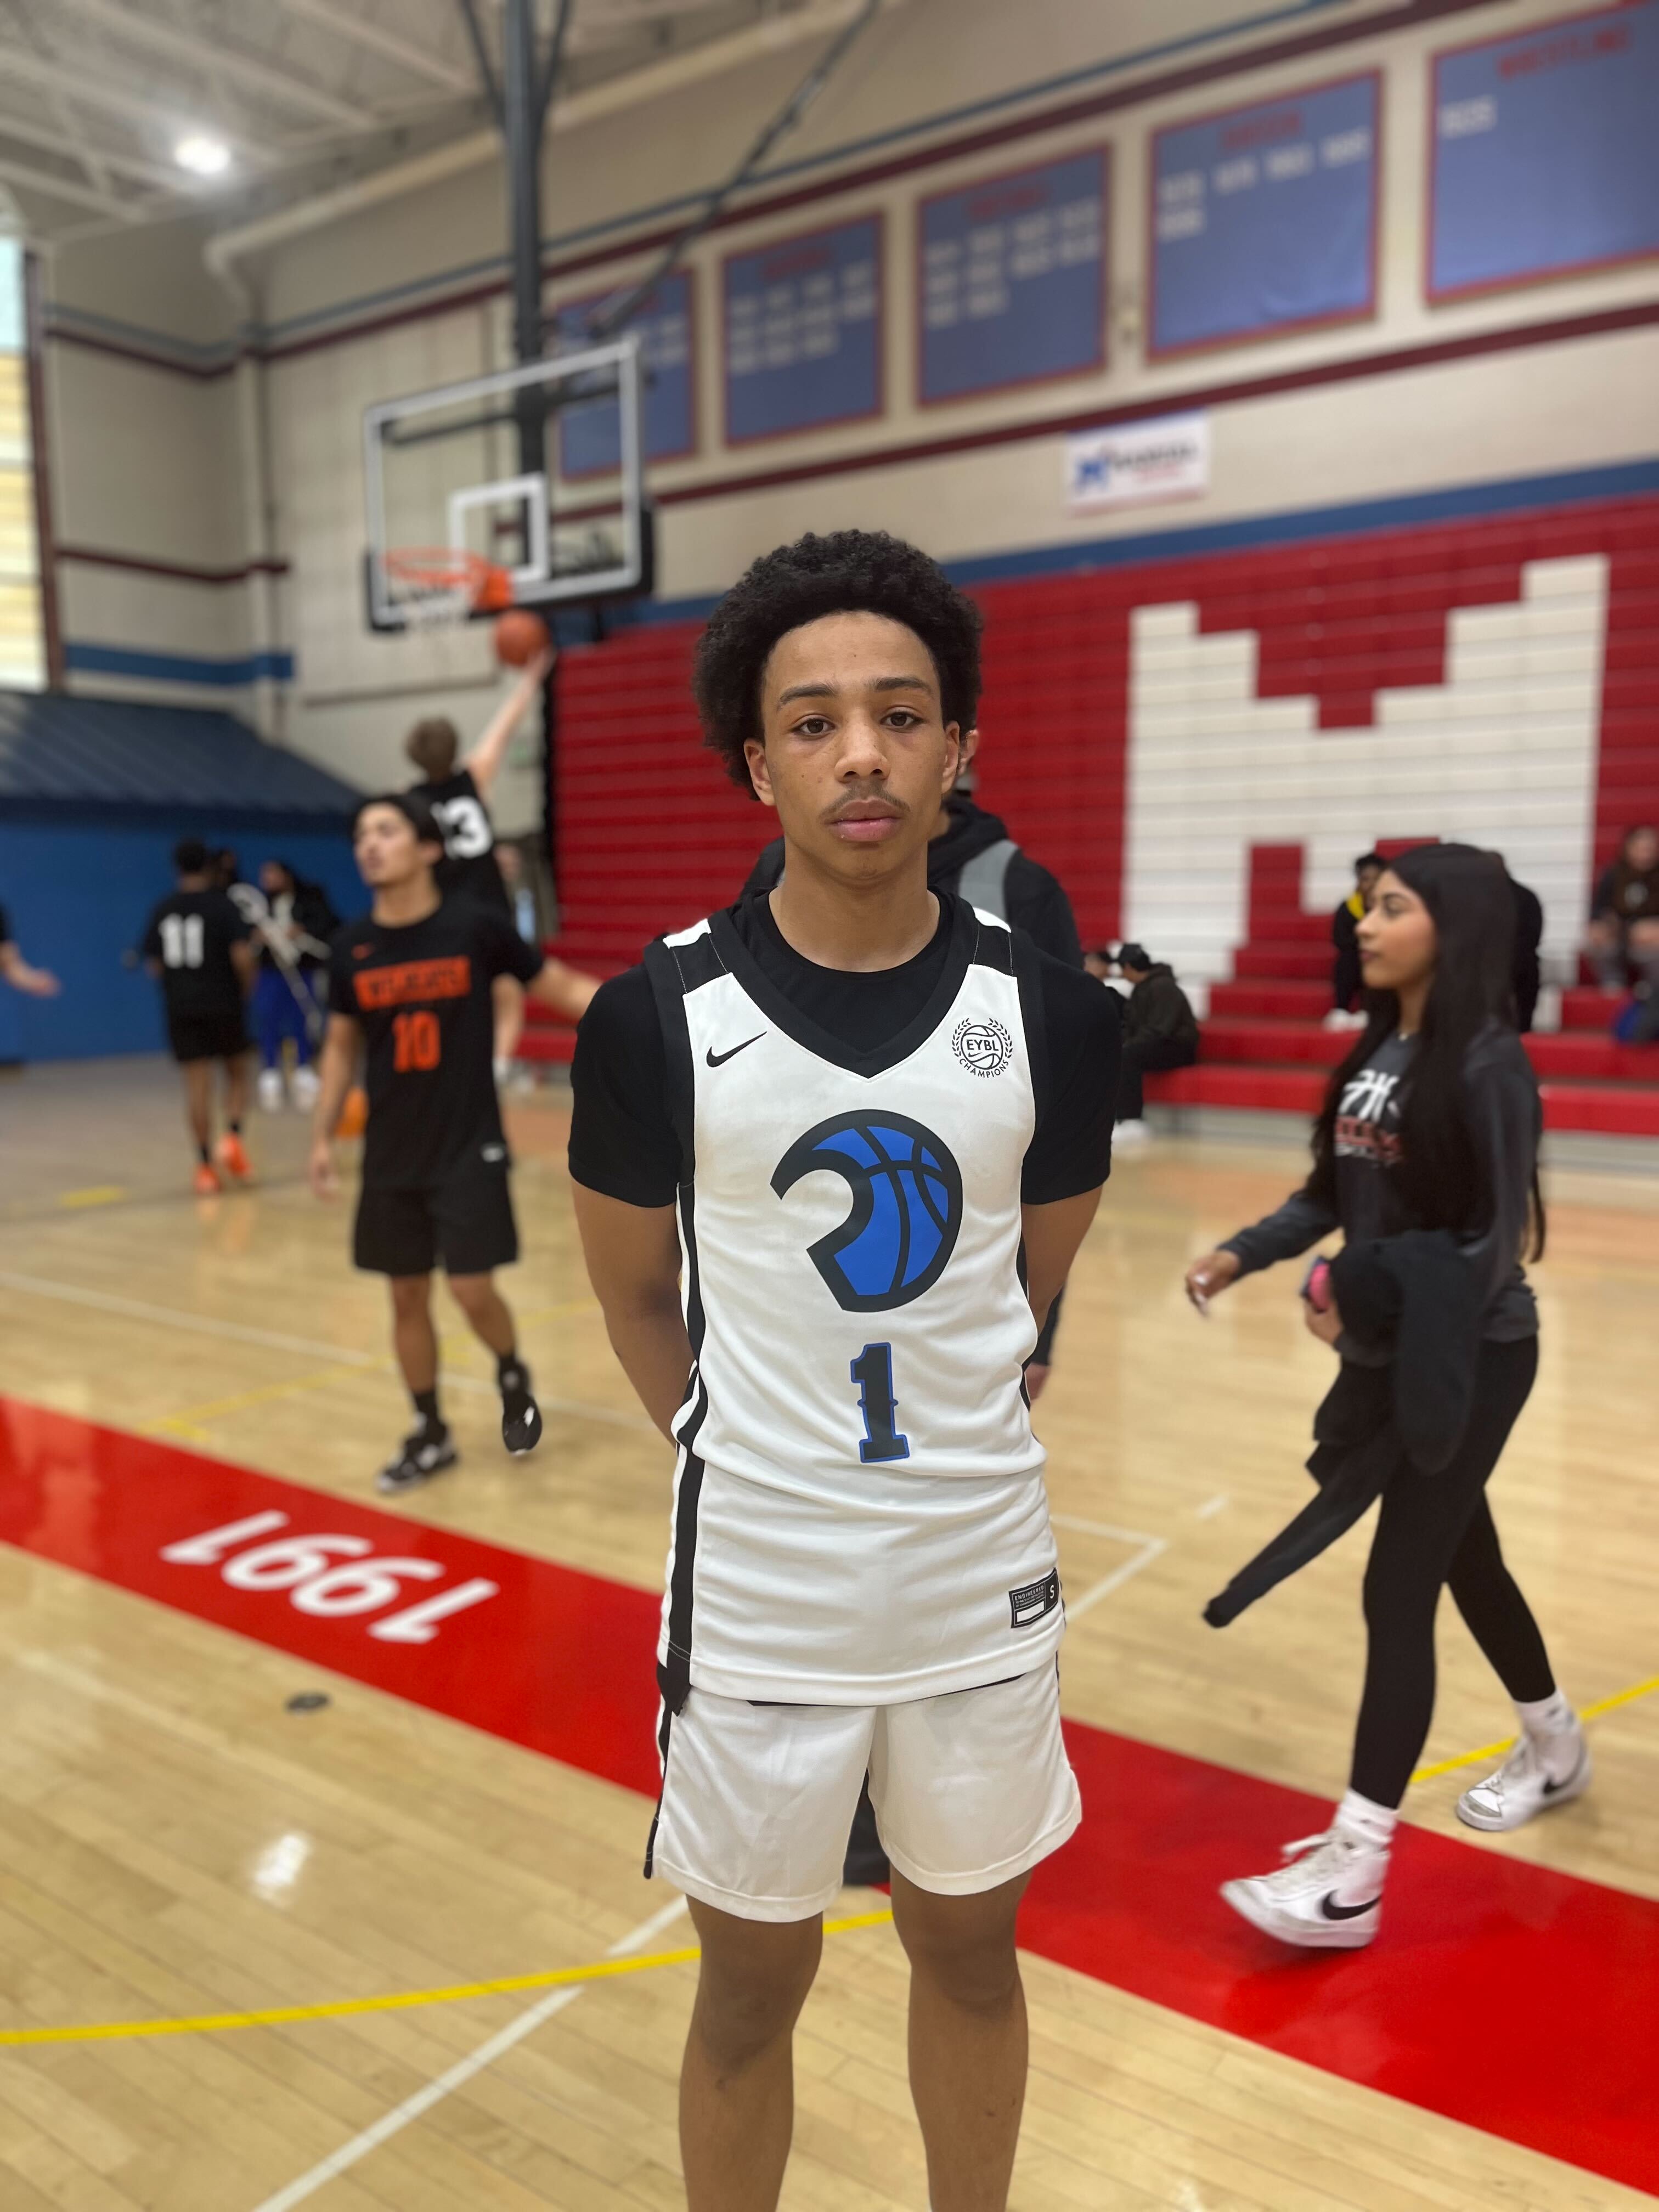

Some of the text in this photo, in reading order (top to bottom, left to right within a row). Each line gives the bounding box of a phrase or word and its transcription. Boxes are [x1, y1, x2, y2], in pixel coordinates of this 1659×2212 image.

[159, 913, 204, 969] 11
[392, 1011, 441, 1073] 10
[966, 1039, 999, 1051] EYBL
[960, 1058, 1009, 1078] CHAMPIONS
[850, 1342, 910, 1463] 1
[159, 1508, 500, 1644] 1991
[1014, 1585, 1045, 1601] ENGINEERED
[1049, 1584, 1055, 1599] S
